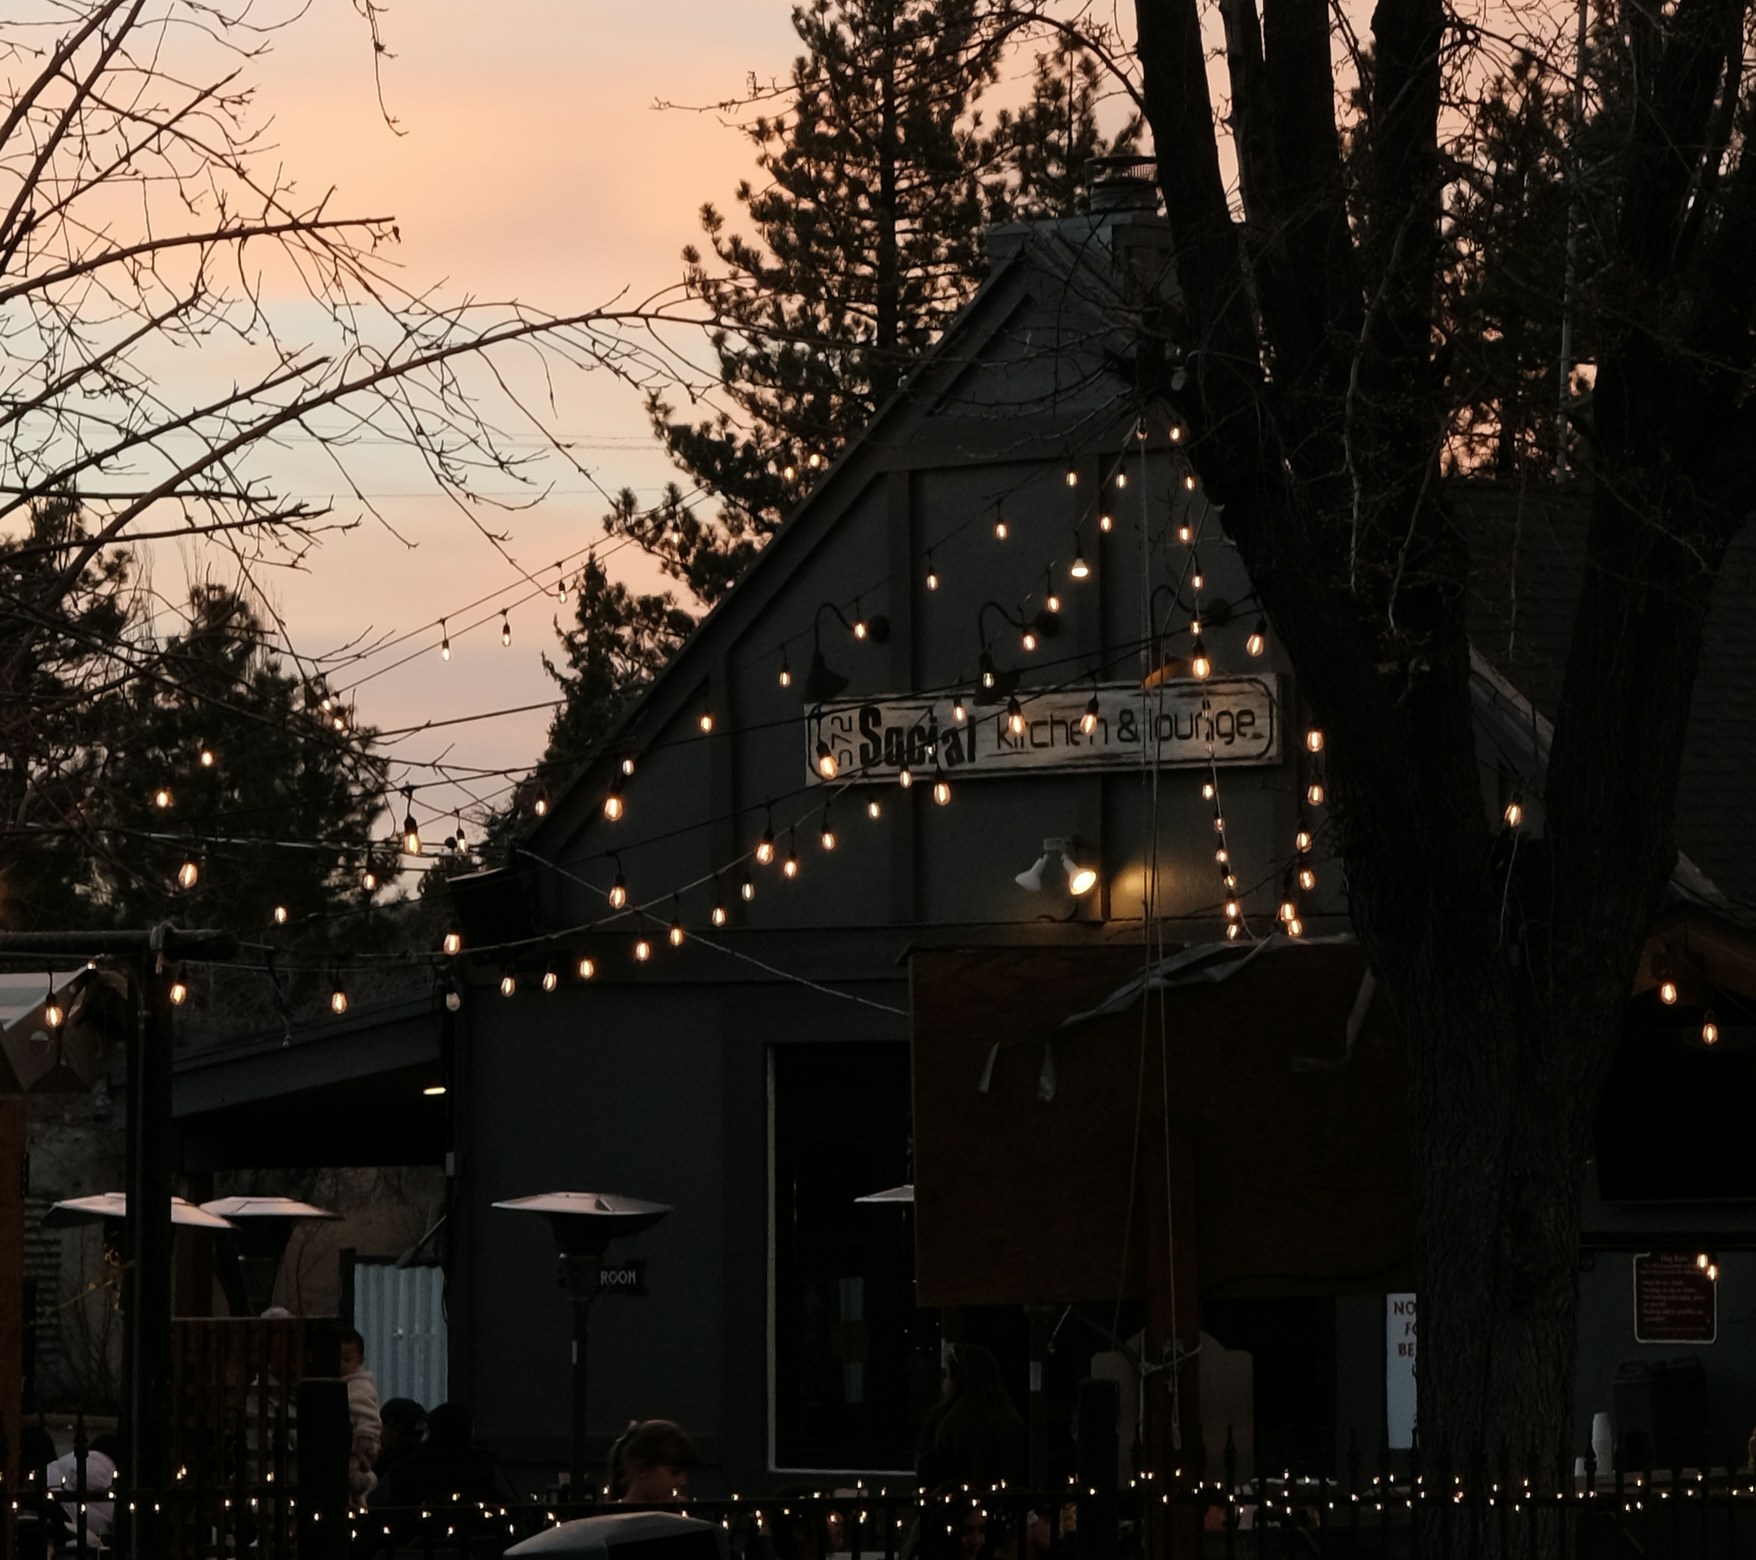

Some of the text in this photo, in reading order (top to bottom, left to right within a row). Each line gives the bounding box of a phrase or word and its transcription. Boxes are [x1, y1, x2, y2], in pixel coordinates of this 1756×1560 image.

[859, 707, 976, 768] Social
[1116, 708, 1140, 743] &
[1148, 708, 1257, 746] lounge
